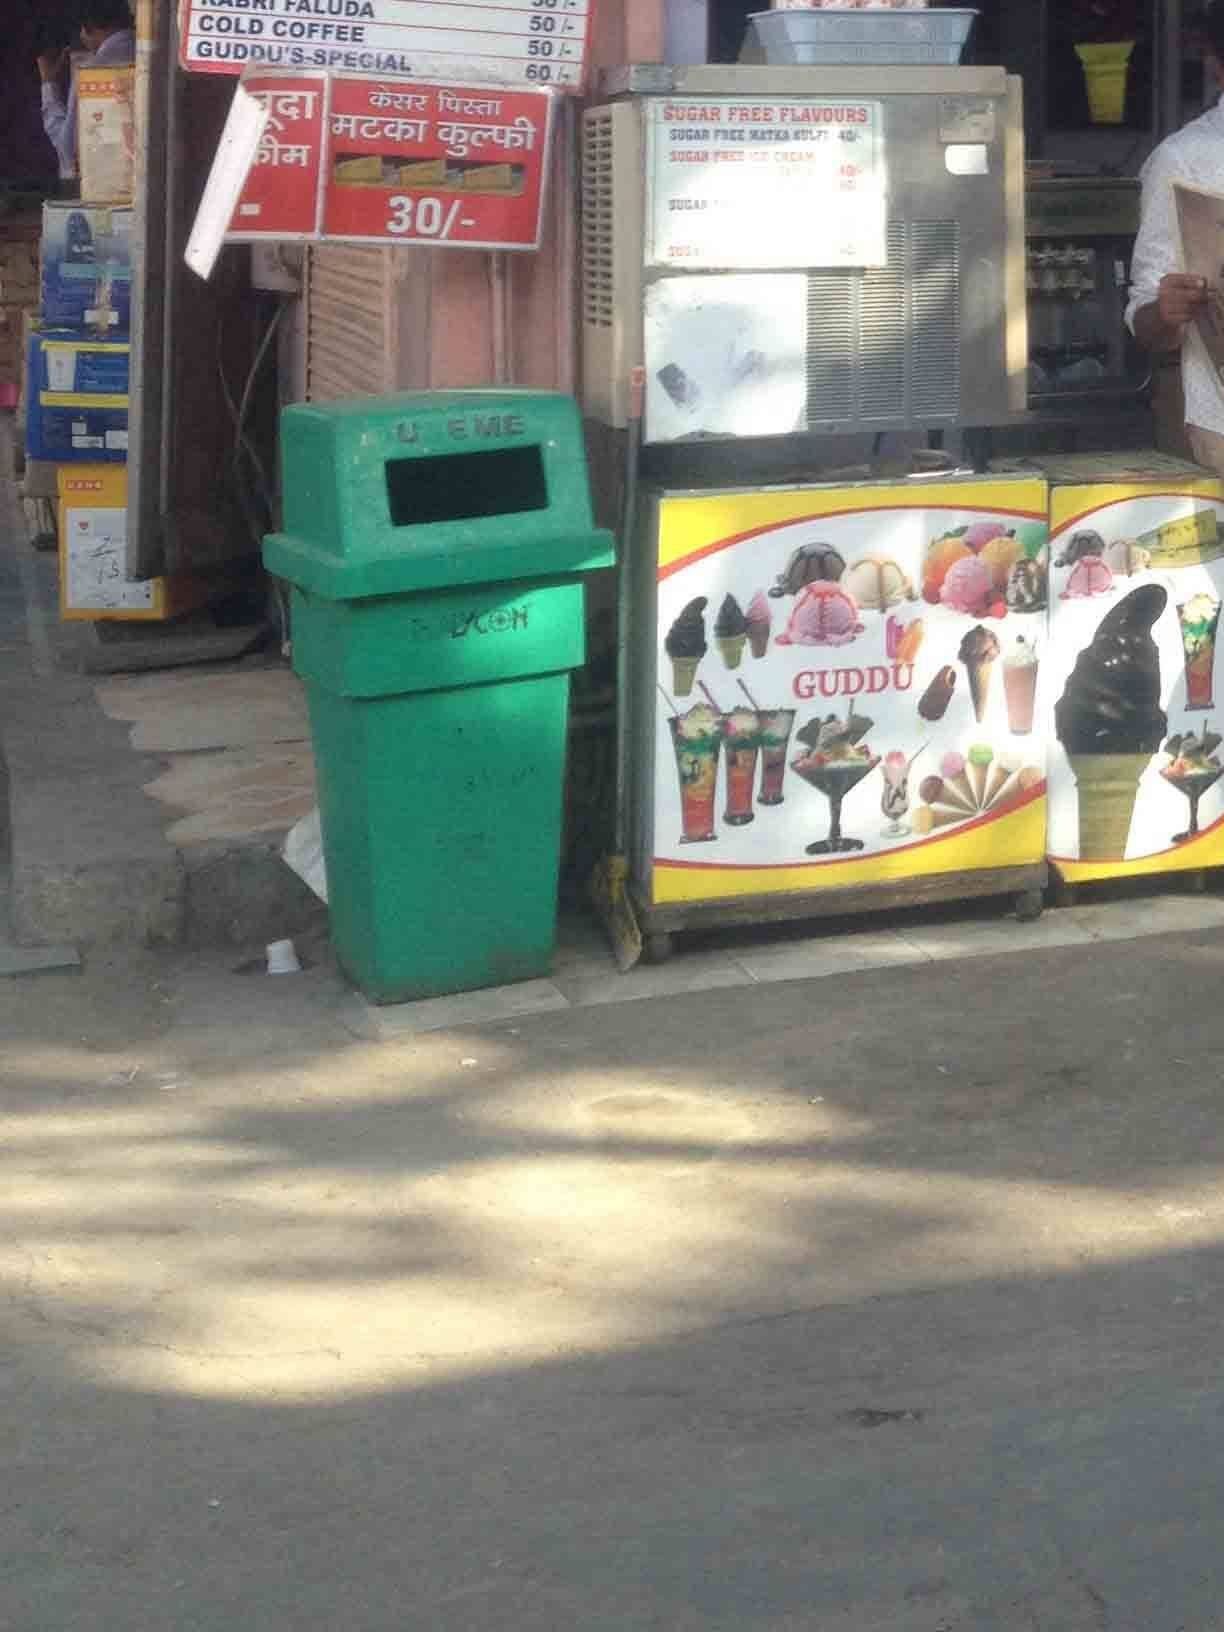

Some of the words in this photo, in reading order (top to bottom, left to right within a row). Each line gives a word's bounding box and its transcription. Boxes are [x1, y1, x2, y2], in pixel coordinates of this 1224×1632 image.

[198, 15, 264, 35] COLD
[272, 20, 365, 42] COFFEE
[197, 41, 412, 72] GUDDU'S-SPECIAL
[663, 105, 721, 121] SUGAR
[728, 107, 775, 122] FREE
[779, 107, 868, 123] FLAVOURS
[330, 112, 429, 142] मटका
[437, 116, 537, 157] कुल्फी
[669, 129, 710, 142] SUGAR
[714, 129, 745, 142] FREE
[386, 195, 476, 239] 30/-
[790, 663, 915, 700] GUDDU
